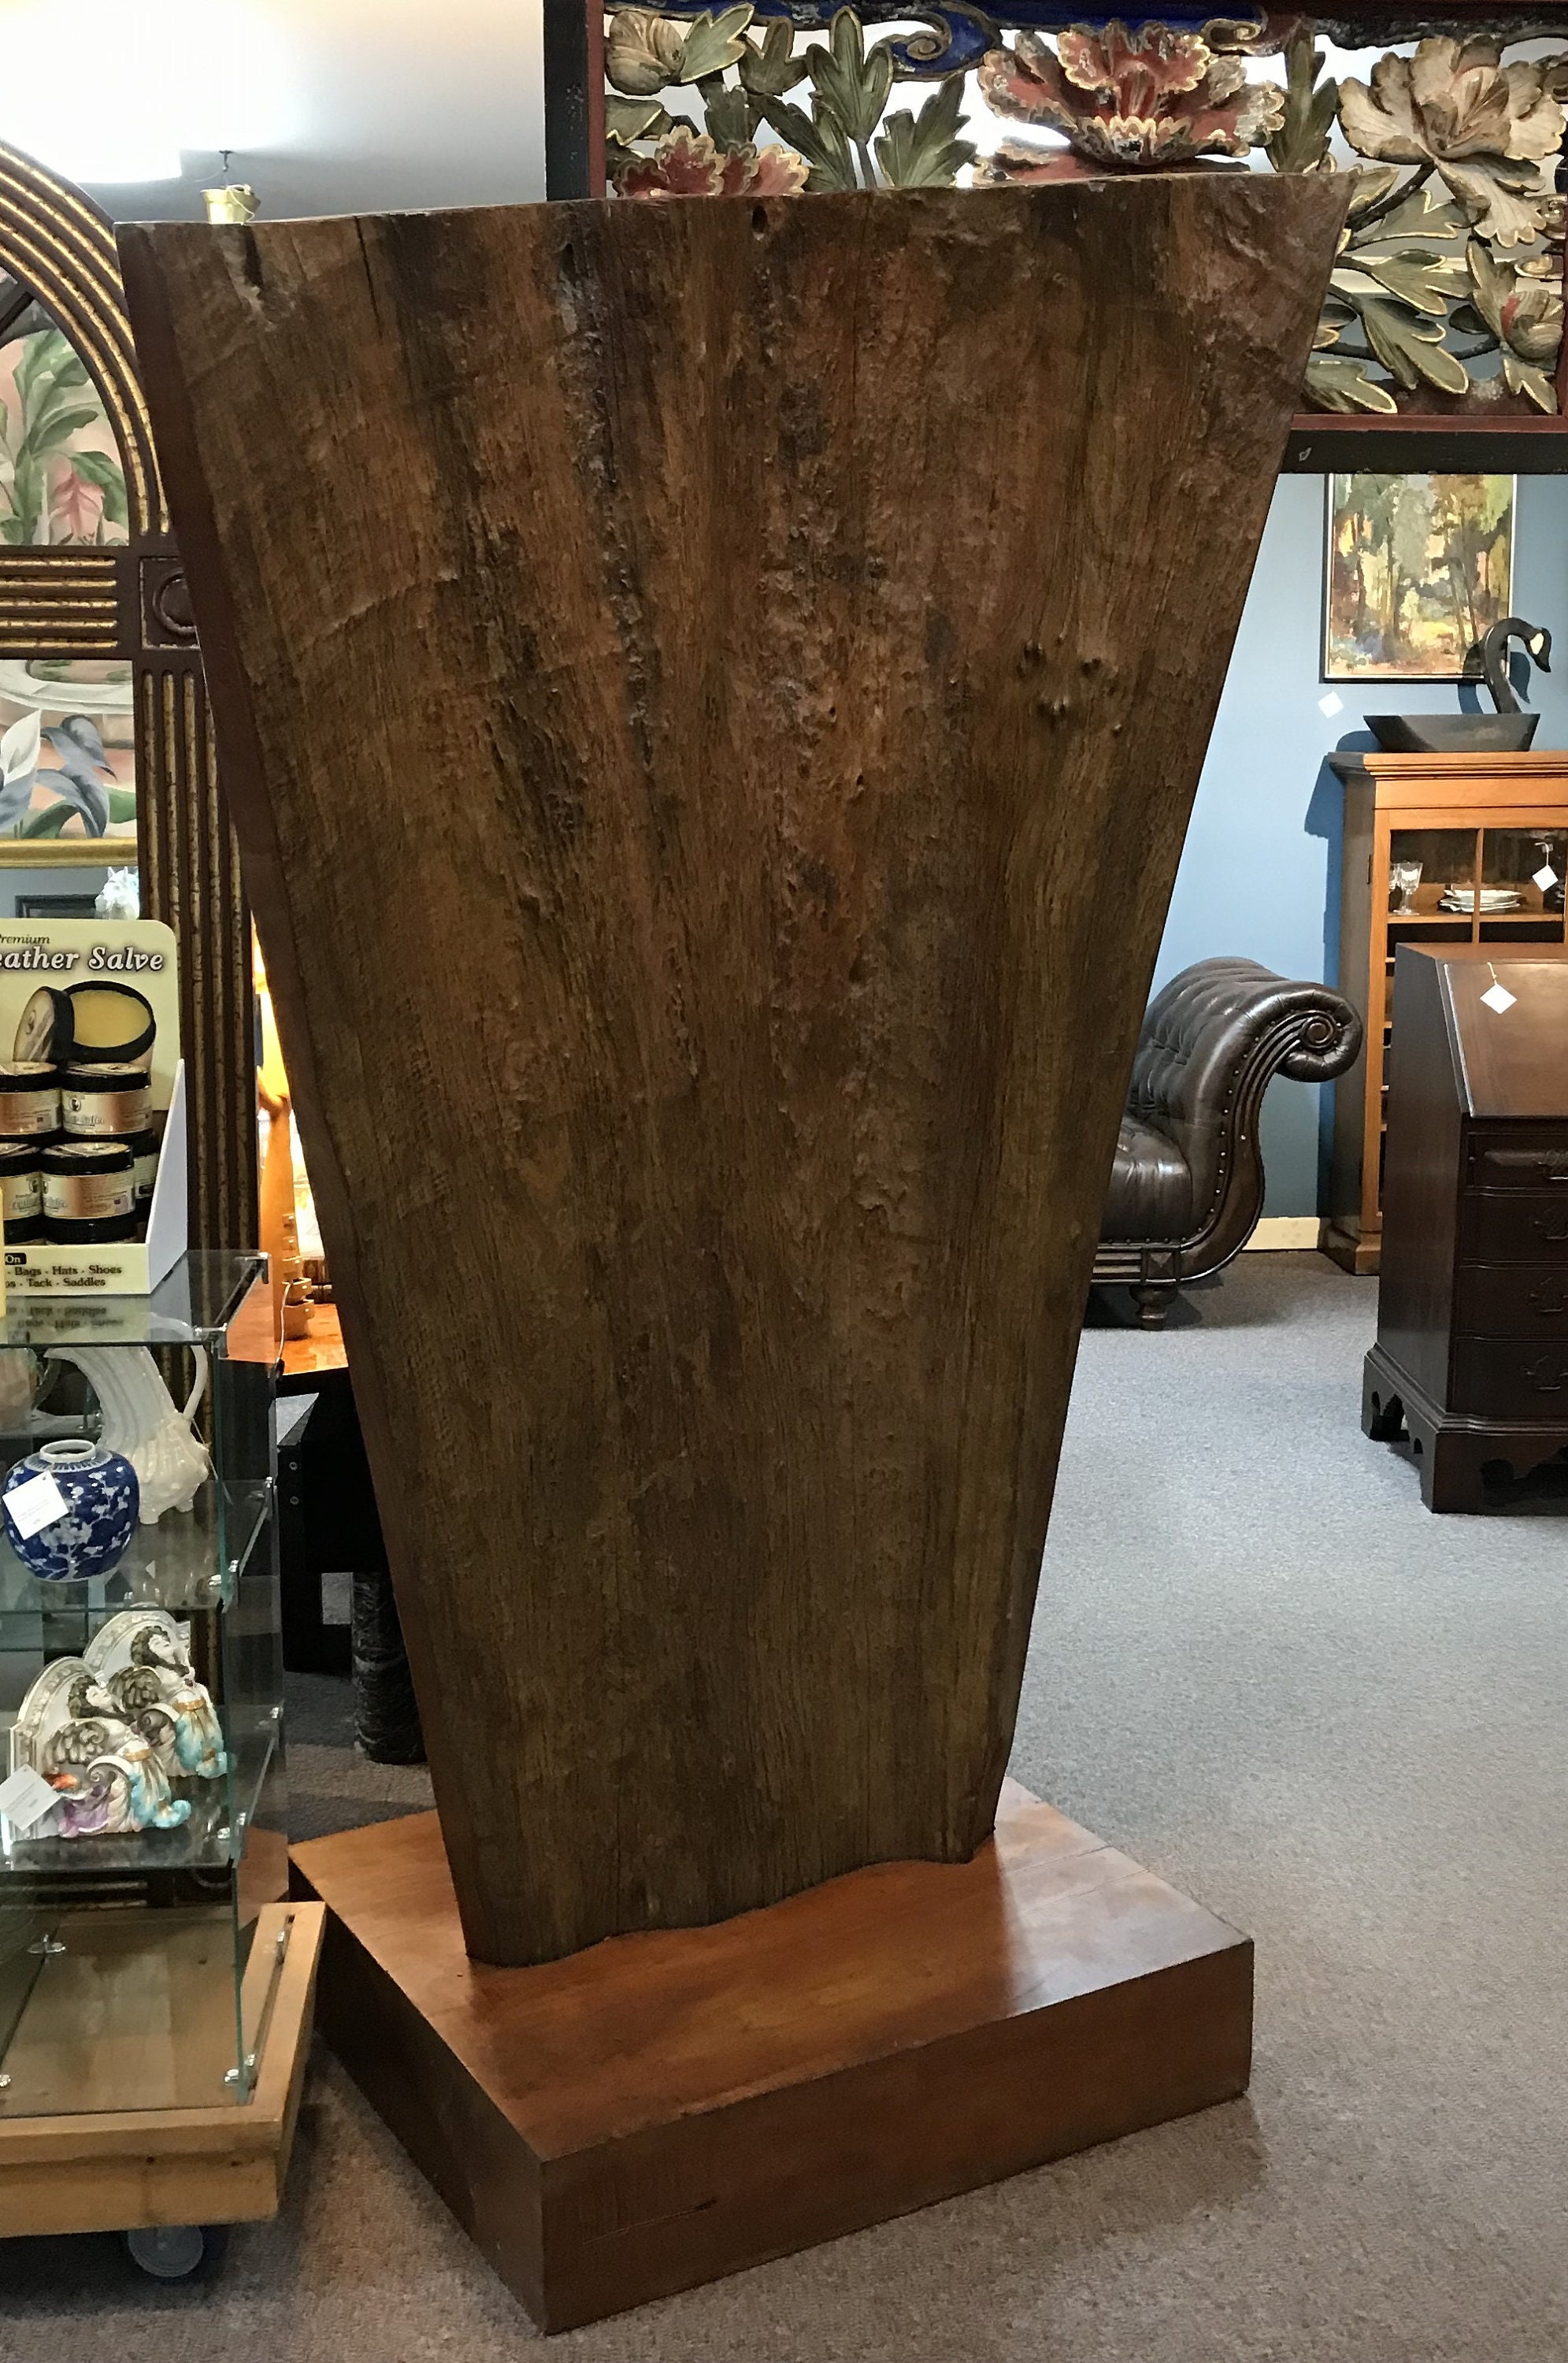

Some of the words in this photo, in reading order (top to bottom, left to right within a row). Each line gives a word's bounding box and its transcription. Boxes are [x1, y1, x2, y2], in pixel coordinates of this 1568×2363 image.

[0, 946, 80, 970] ather
[88, 946, 164, 971] Salve
[14, 1267, 42, 1277] Bags
[52, 1266, 78, 1275] Hats
[88, 1265, 122, 1274] Shoes
[26, 1278, 53, 1287] Tack
[63, 1277, 106, 1286] Saddles
